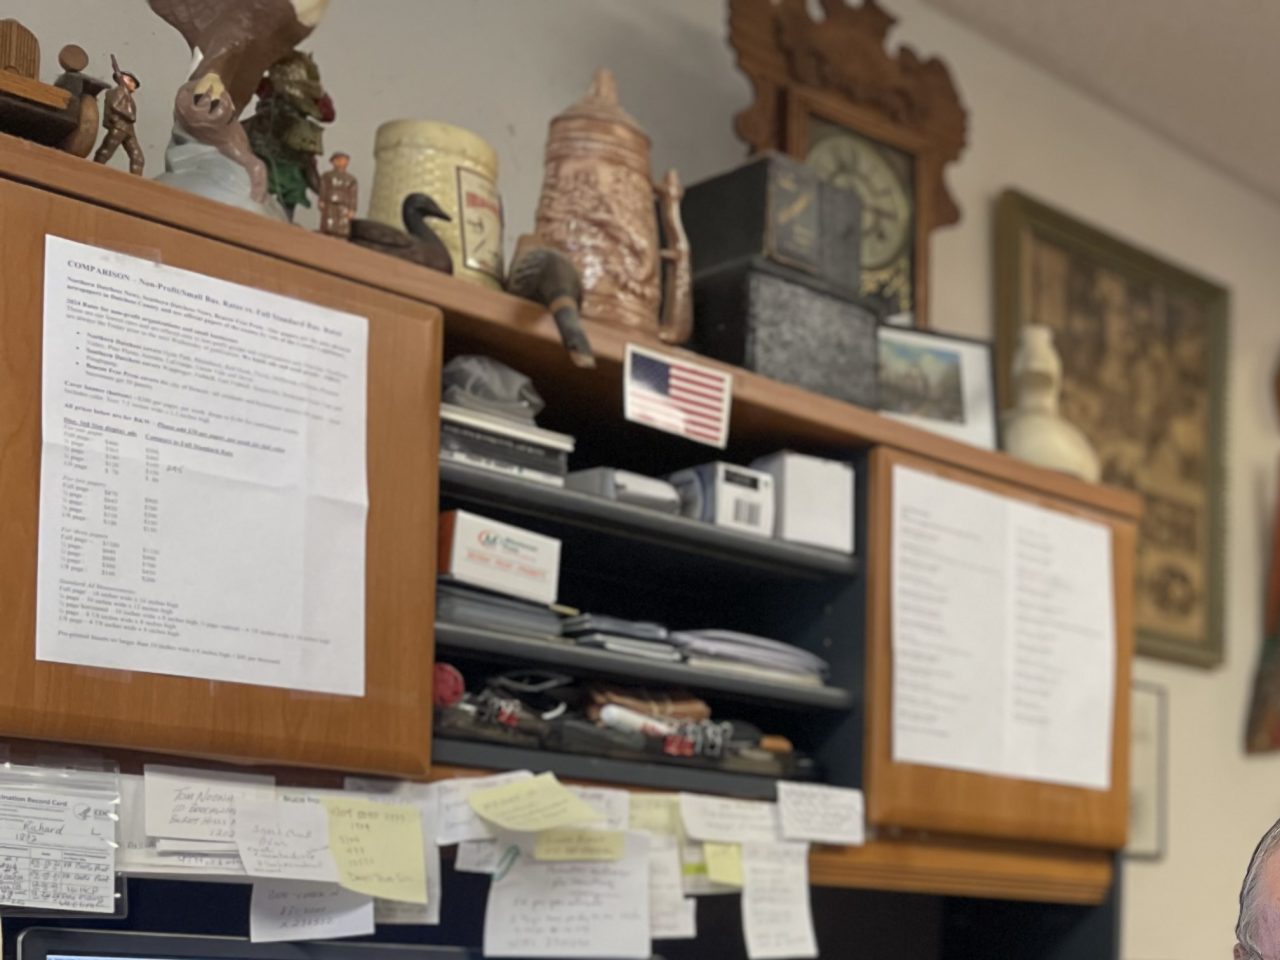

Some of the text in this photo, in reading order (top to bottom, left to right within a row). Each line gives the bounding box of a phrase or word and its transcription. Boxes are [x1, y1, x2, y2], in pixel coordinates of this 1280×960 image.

[67, 260, 129, 281] COMPARISON
[139, 279, 202, 300] Non-Profit/Small
[52, 799, 68, 808] Card
